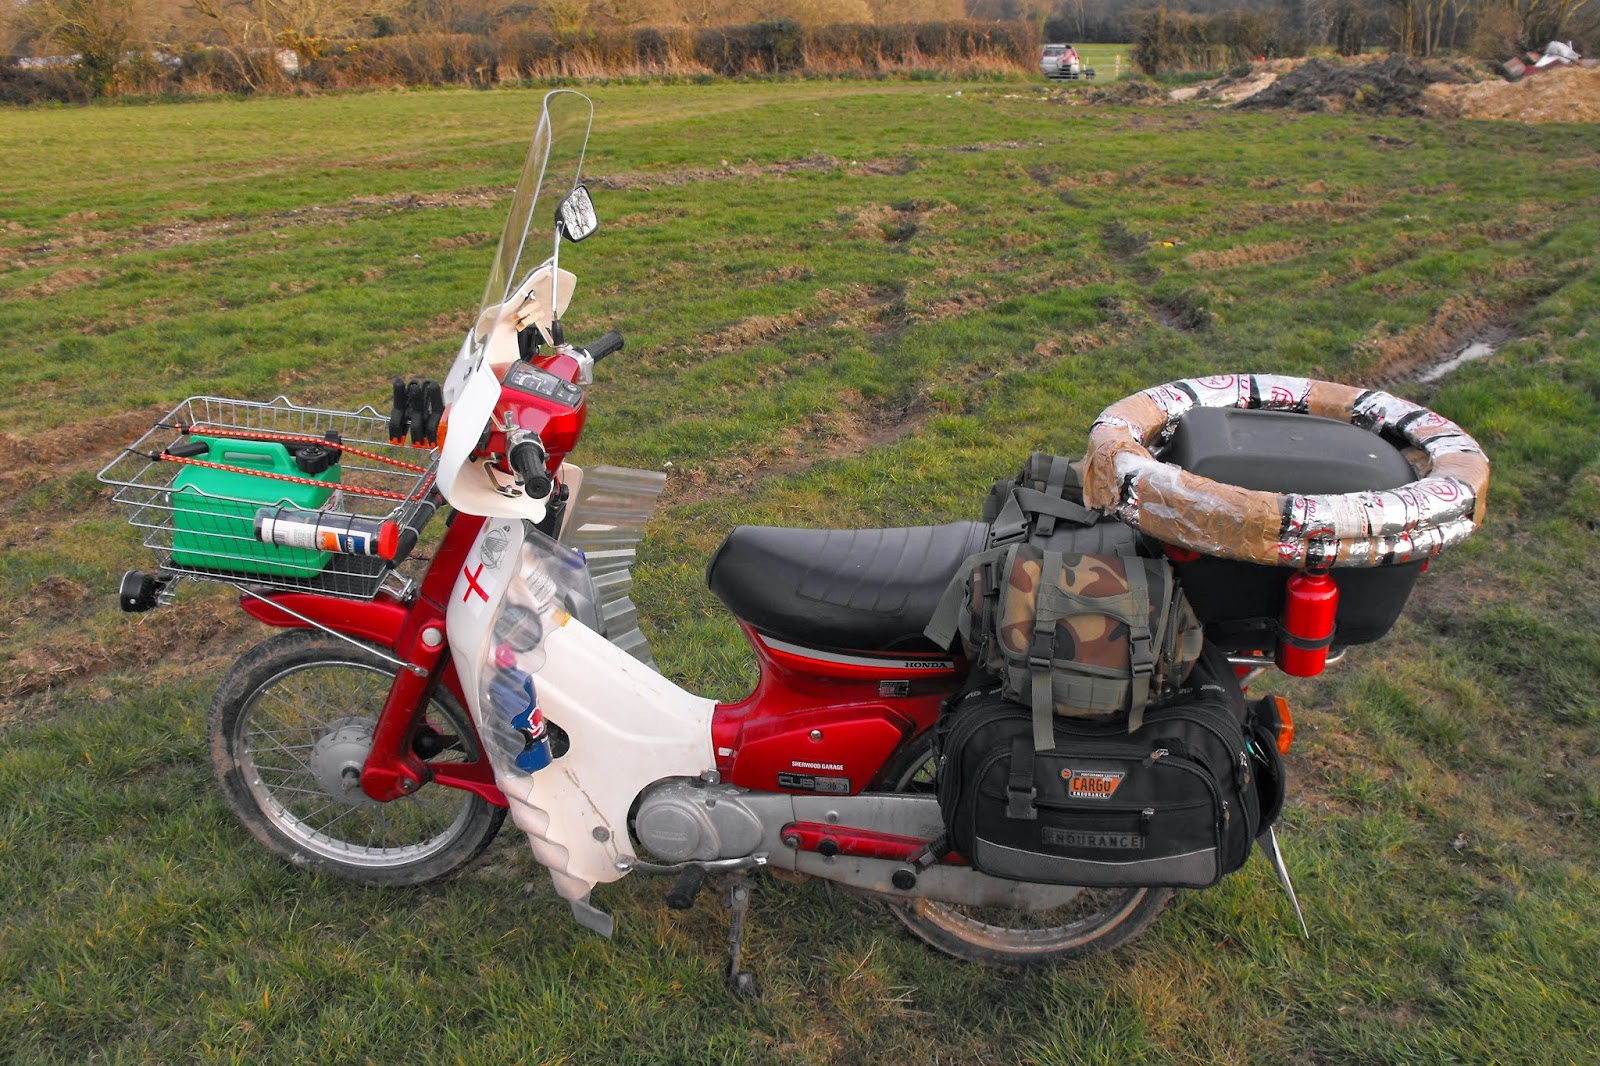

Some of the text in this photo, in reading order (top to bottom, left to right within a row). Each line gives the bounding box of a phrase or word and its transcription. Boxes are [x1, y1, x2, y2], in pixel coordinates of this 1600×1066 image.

[791, 760, 844, 771] SHERWOOD GARAGE
[778, 775, 814, 788] CUB
[1073, 777, 1111, 792] CARGO
